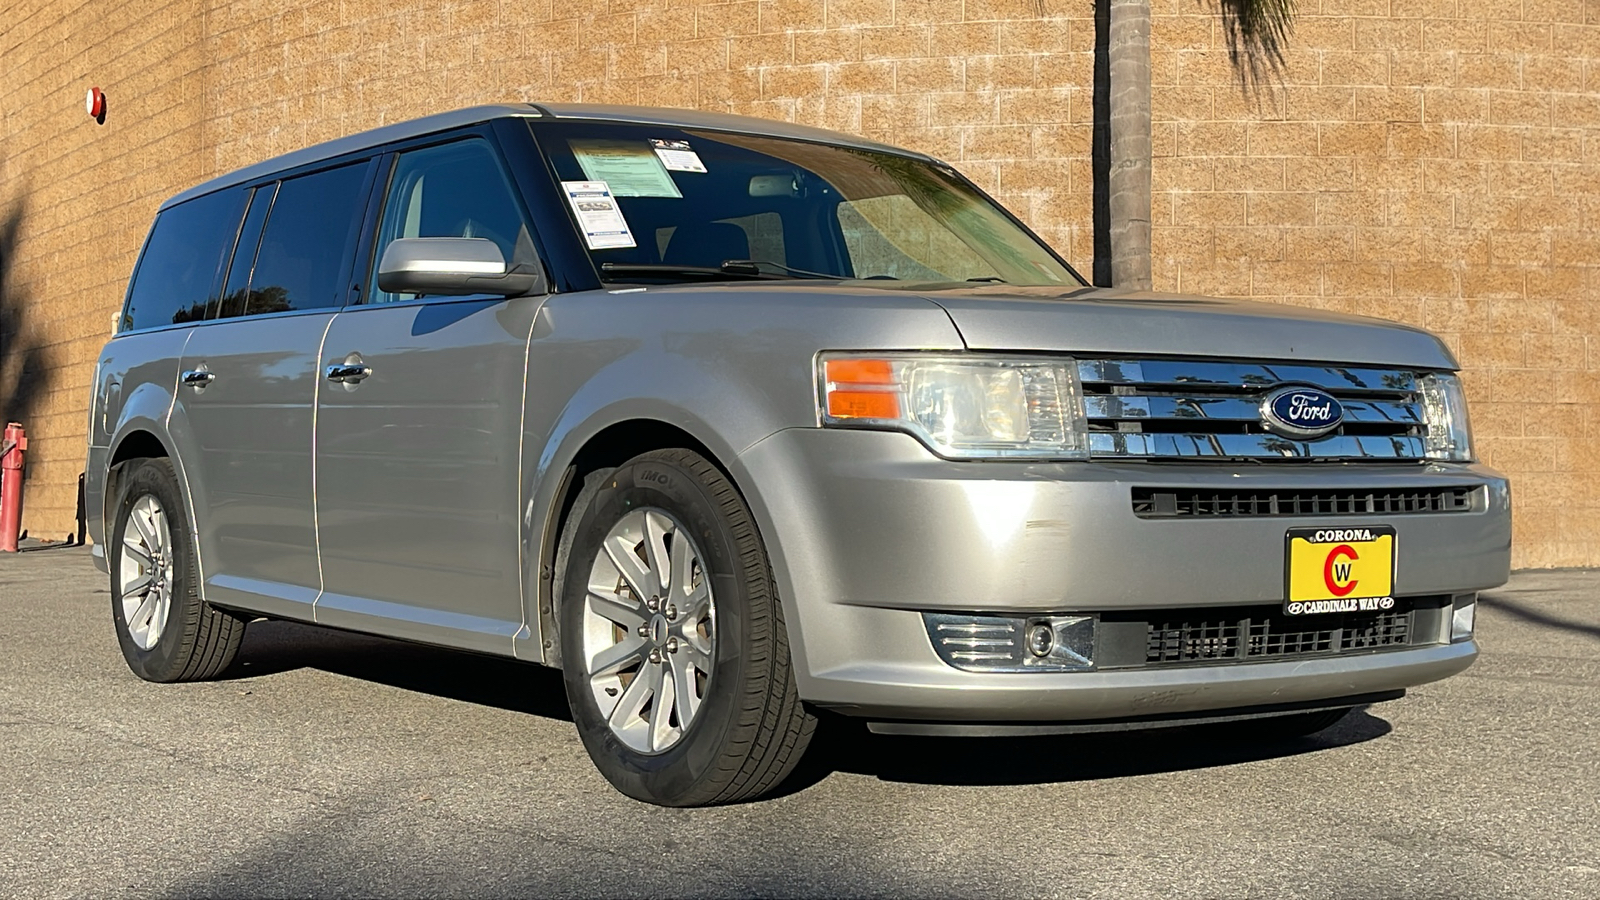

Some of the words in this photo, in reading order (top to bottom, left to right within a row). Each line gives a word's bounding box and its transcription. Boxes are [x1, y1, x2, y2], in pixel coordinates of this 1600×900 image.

[1289, 394, 1331, 420] Ford
[1315, 530, 1371, 541] CORONA
[1303, 600, 1358, 614] CARDINALE
[1359, 597, 1380, 610] WAY
